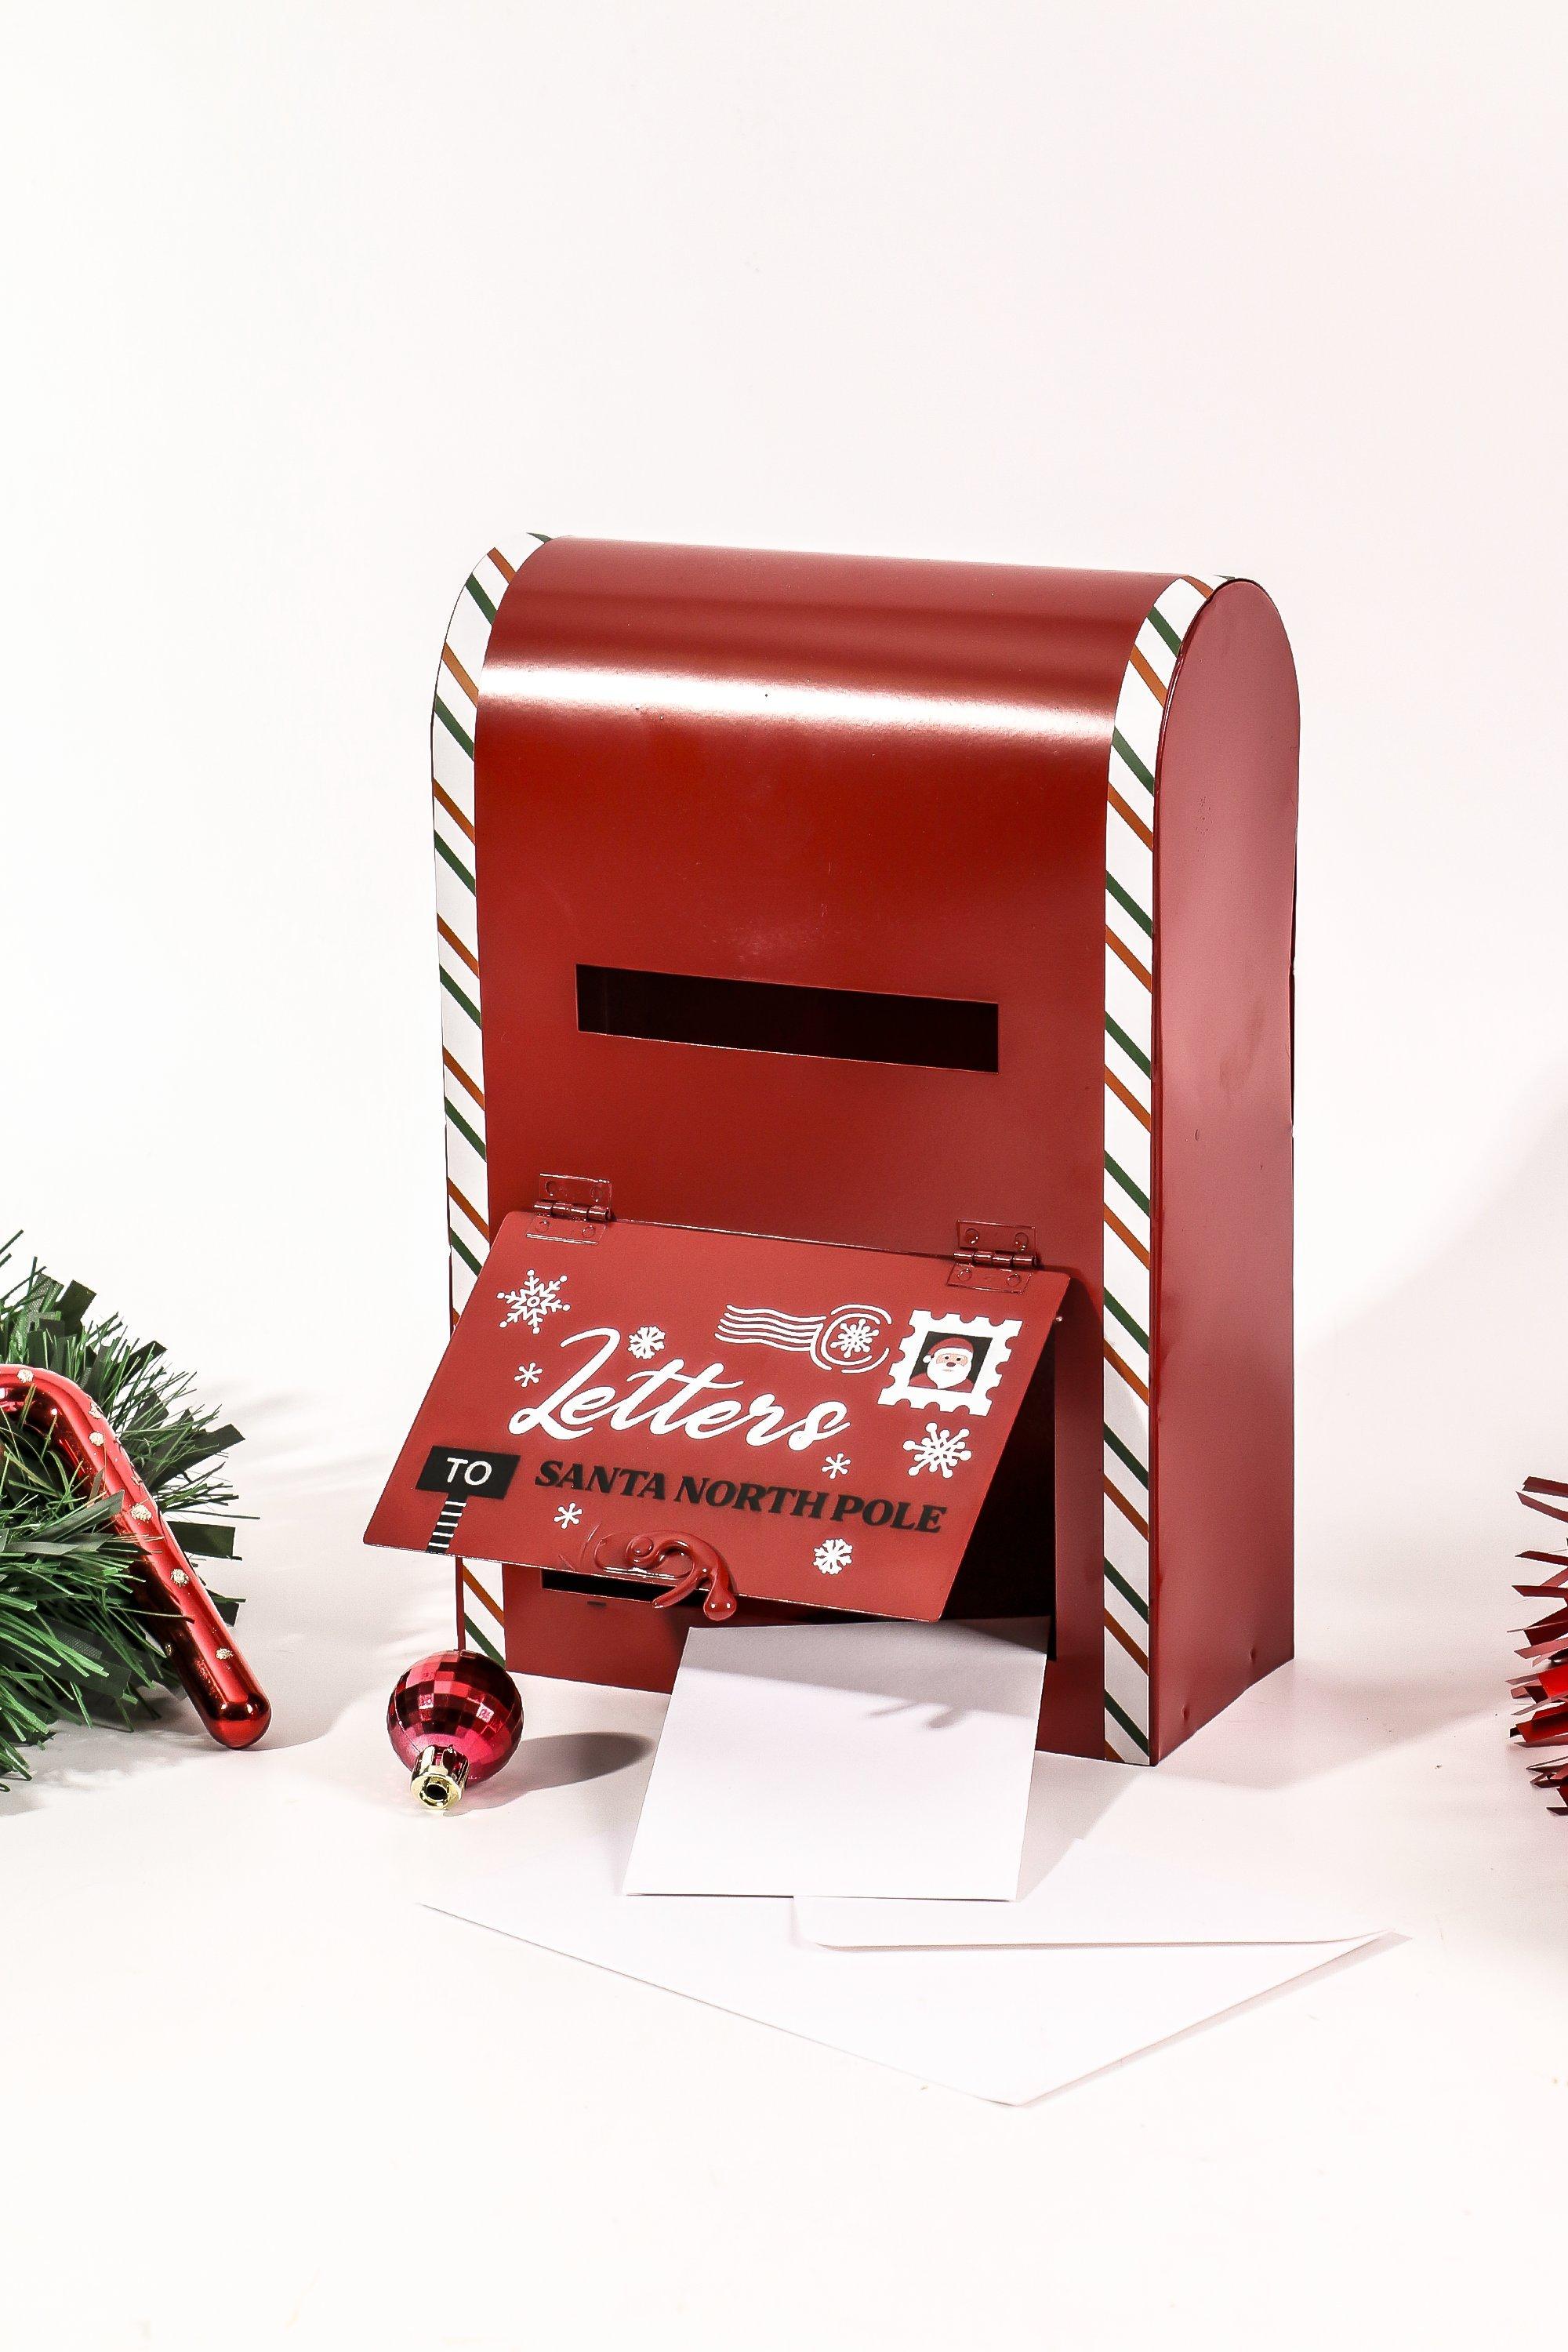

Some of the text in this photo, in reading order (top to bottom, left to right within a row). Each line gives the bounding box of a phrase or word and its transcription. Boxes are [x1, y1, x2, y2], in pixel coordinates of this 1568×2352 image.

[508, 1327, 851, 1452] Letters
[446, 1457, 492, 1486] TO
[535, 1459, 947, 1534] SANTA NORTH POLE
